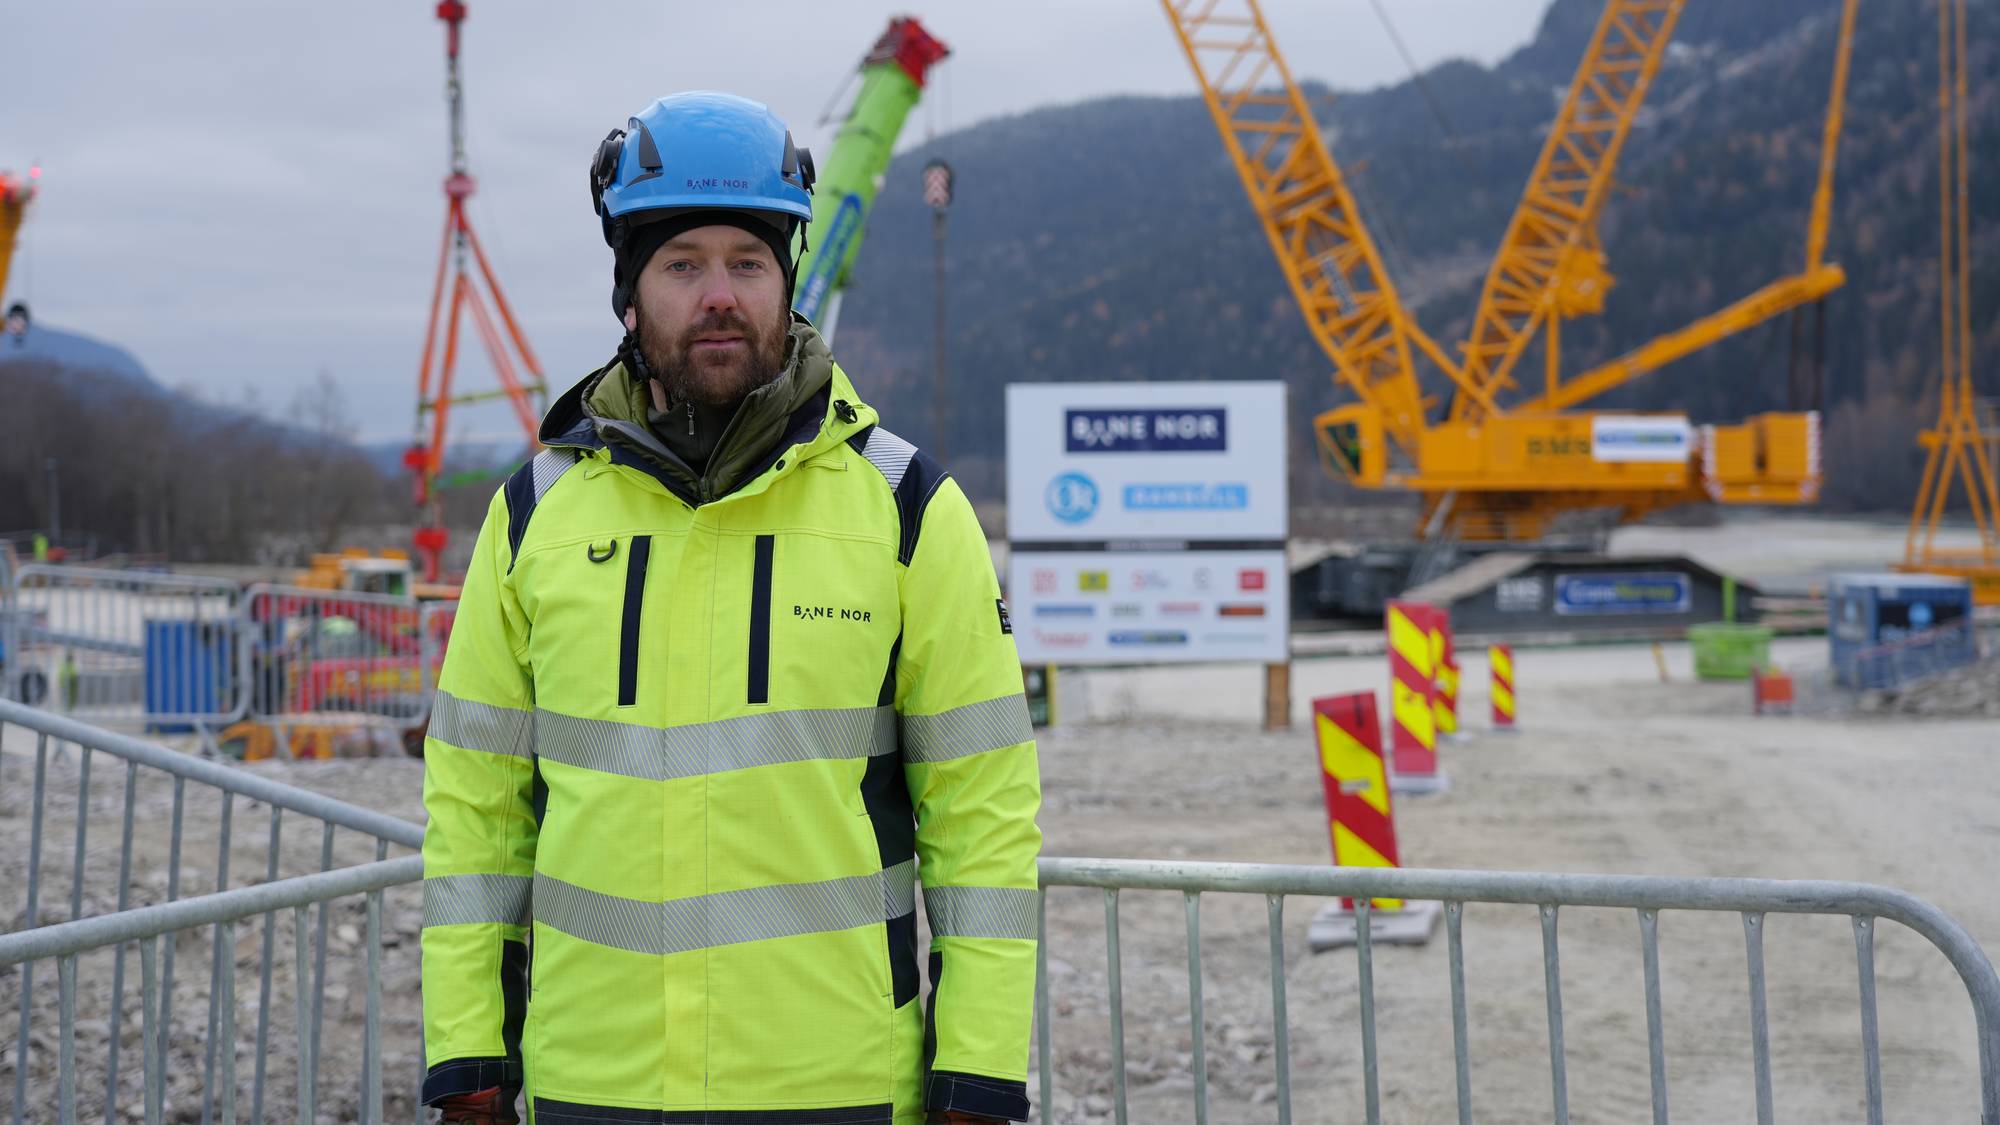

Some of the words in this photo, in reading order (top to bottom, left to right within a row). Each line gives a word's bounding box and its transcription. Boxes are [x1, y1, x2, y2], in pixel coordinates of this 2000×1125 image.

[686, 178, 719, 190] BANE
[722, 178, 749, 190] NOR
[1071, 415, 1148, 446] BANE
[1155, 414, 1219, 440] NOR
[793, 605, 834, 620] BANE
[841, 608, 871, 623] NOR
